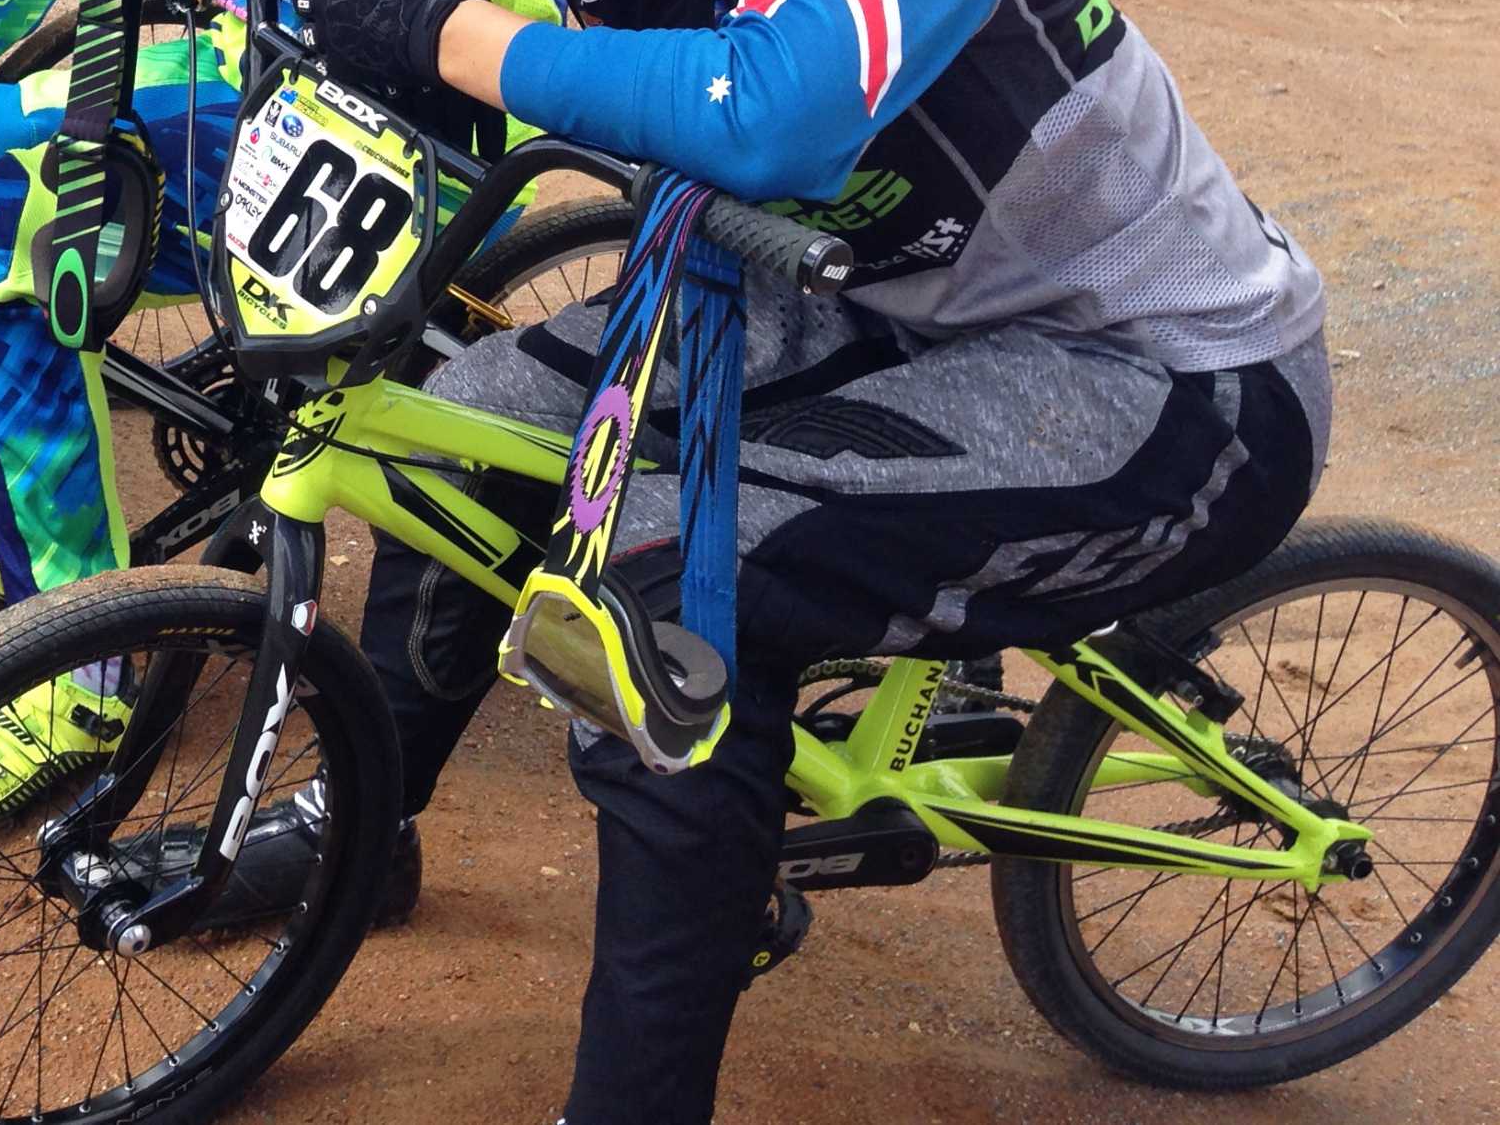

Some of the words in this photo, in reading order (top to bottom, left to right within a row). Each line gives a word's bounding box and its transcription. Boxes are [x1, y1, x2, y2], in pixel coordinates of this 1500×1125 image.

[316, 79, 389, 132] BOX
[269, 131, 302, 158] SUBARU
[270, 155, 291, 173] BMX
[235, 193, 262, 220] OAKLEY
[248, 138, 414, 316] 68
[822, 264, 850, 281] odi
[237, 289, 287, 330] BICYCLES
[241, 275, 295, 324] DK
[889, 661, 942, 773] BUCHANAN
[219, 662, 295, 862] BOX
[779, 852, 865, 880] BO
